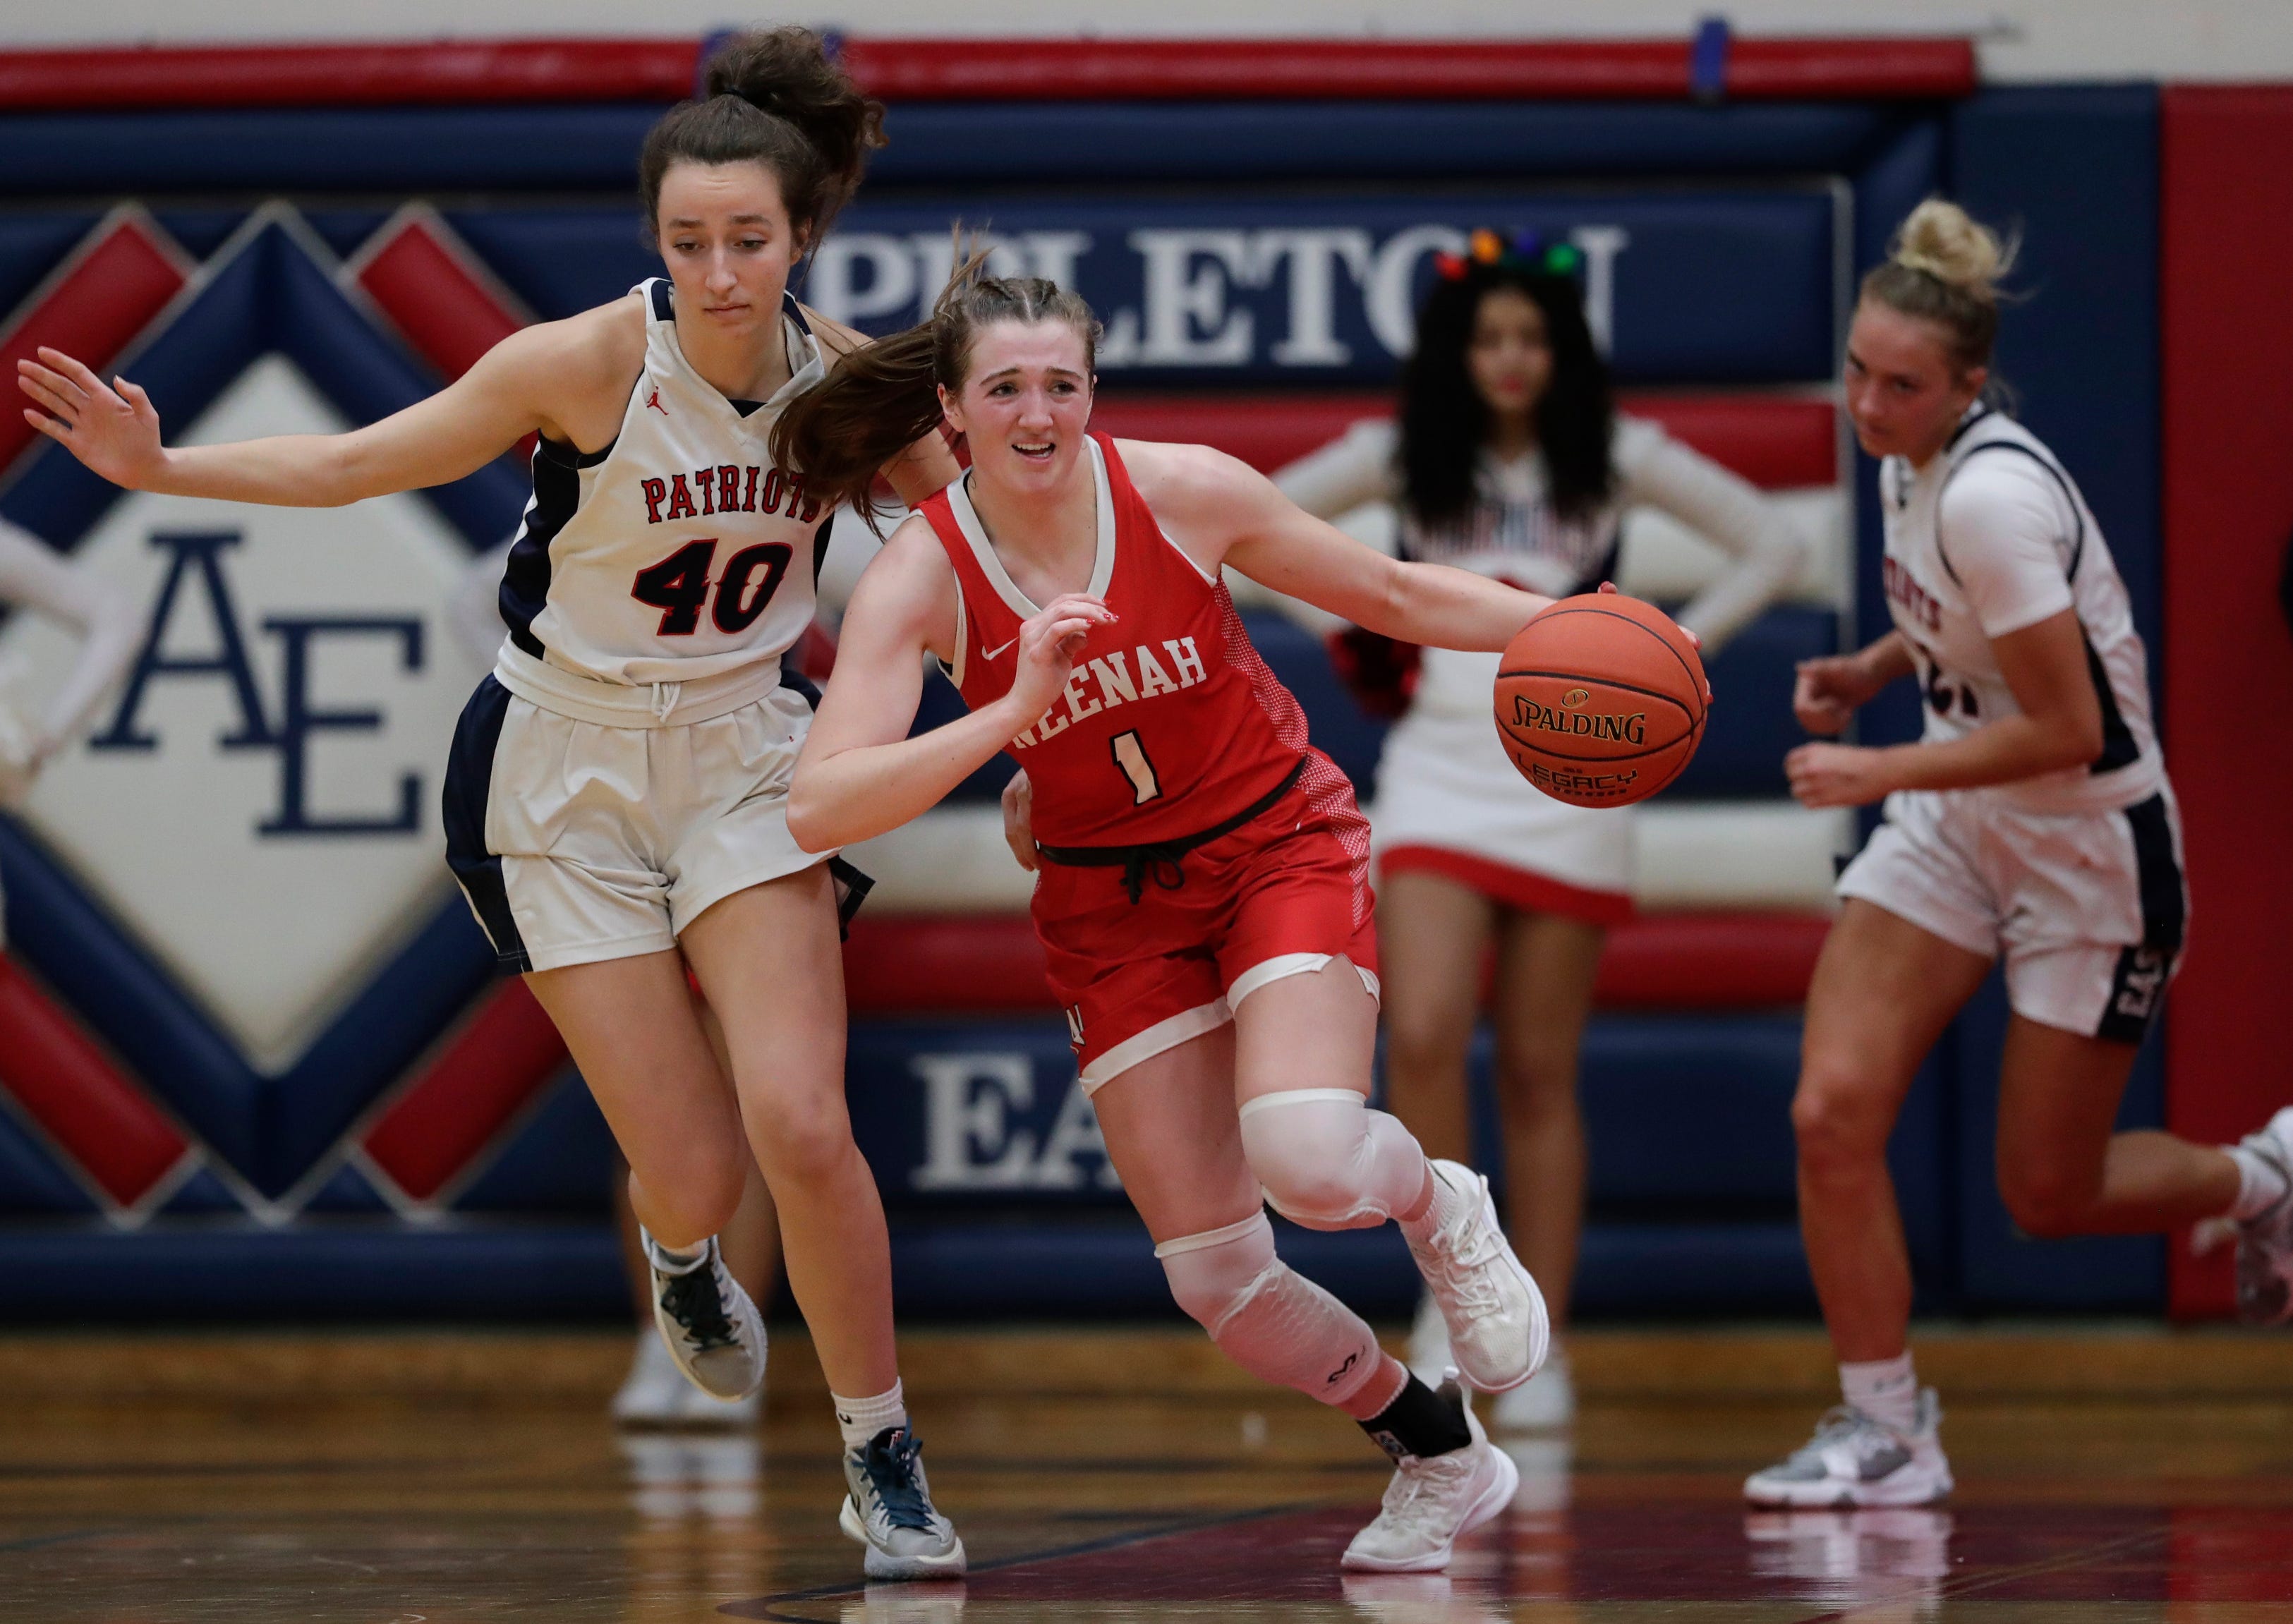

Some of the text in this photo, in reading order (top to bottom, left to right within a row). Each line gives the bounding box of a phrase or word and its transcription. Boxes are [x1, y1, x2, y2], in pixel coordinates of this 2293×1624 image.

[631, 538, 793, 636] 40
[1513, 694, 1645, 745] SPALDING
[1108, 728, 1163, 807] 1
[1517, 752, 1638, 789] LEGACY
